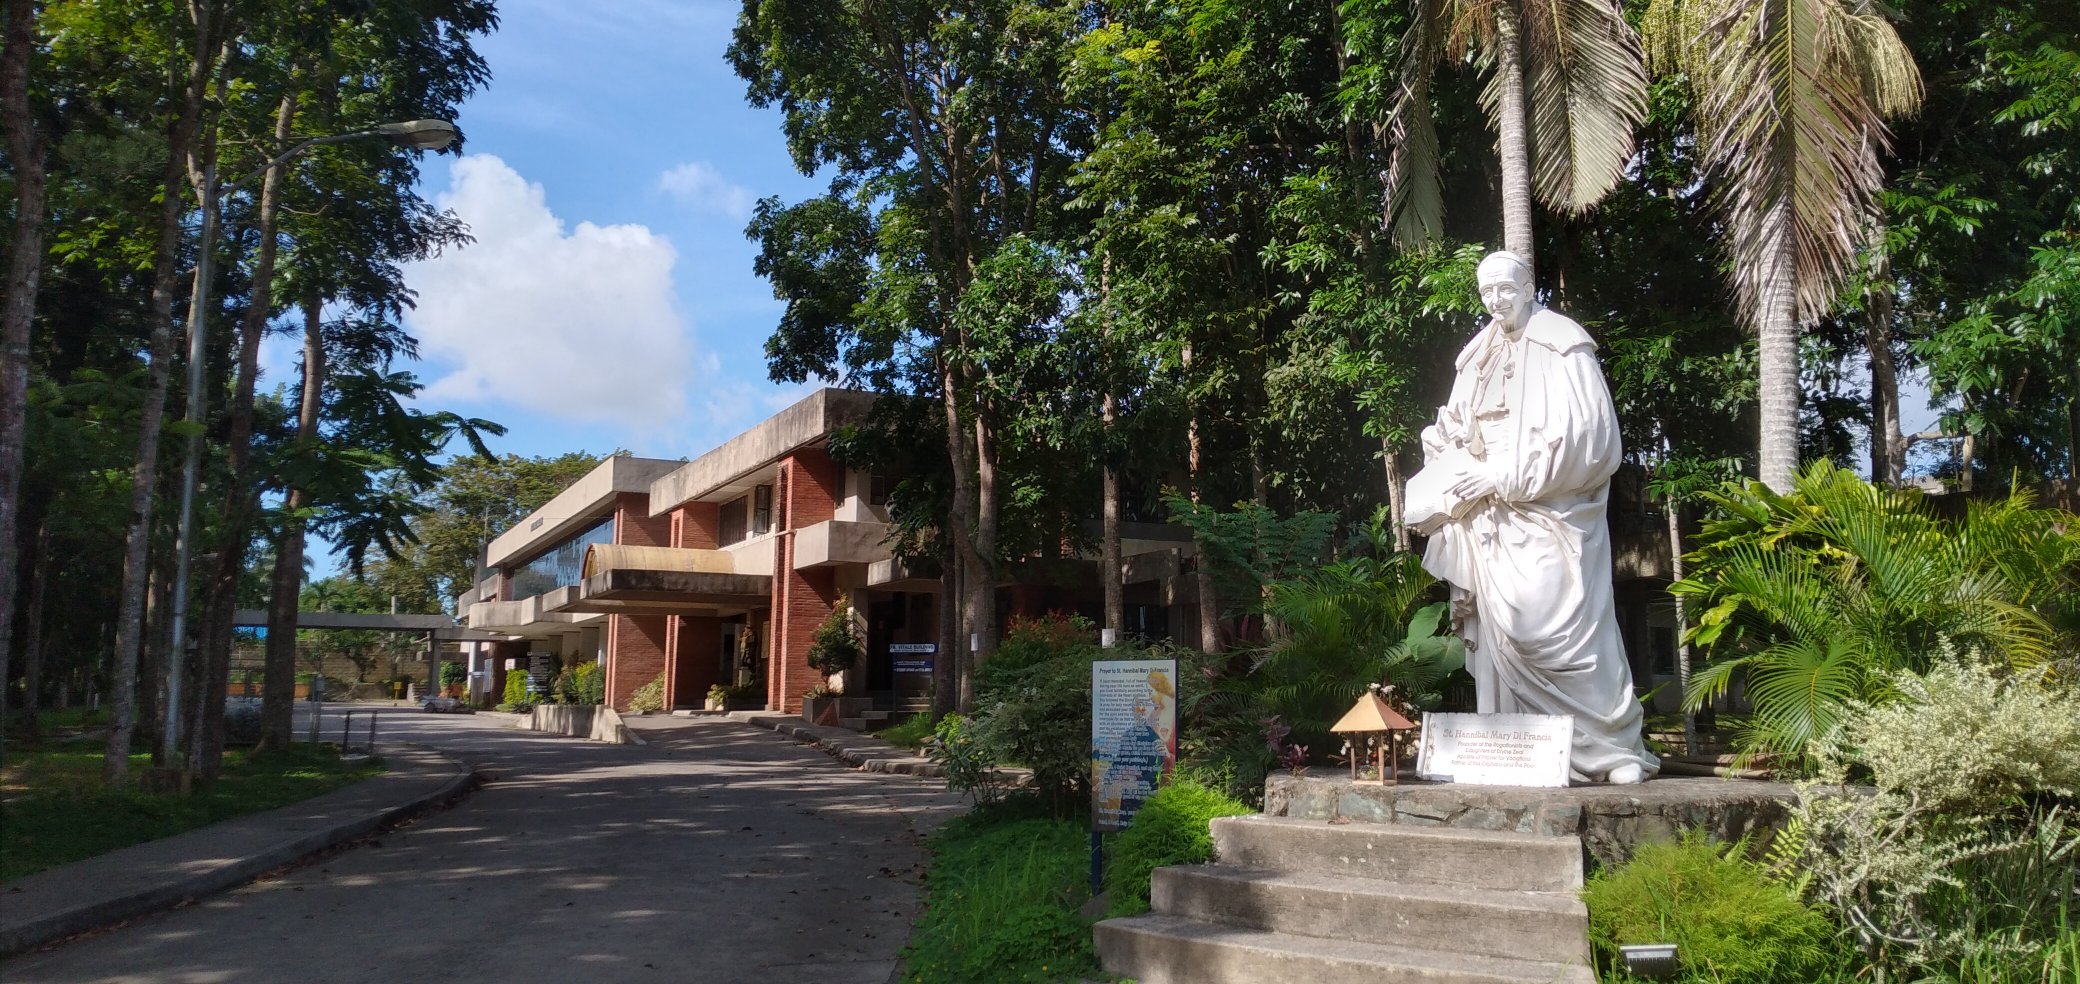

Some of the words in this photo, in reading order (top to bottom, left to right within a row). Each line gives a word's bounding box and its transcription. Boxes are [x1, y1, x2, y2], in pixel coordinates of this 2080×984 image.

[1455, 730, 1488, 739] Hannibal
[1490, 730, 1512, 740] Mary
[1523, 732, 1552, 741] Francia
